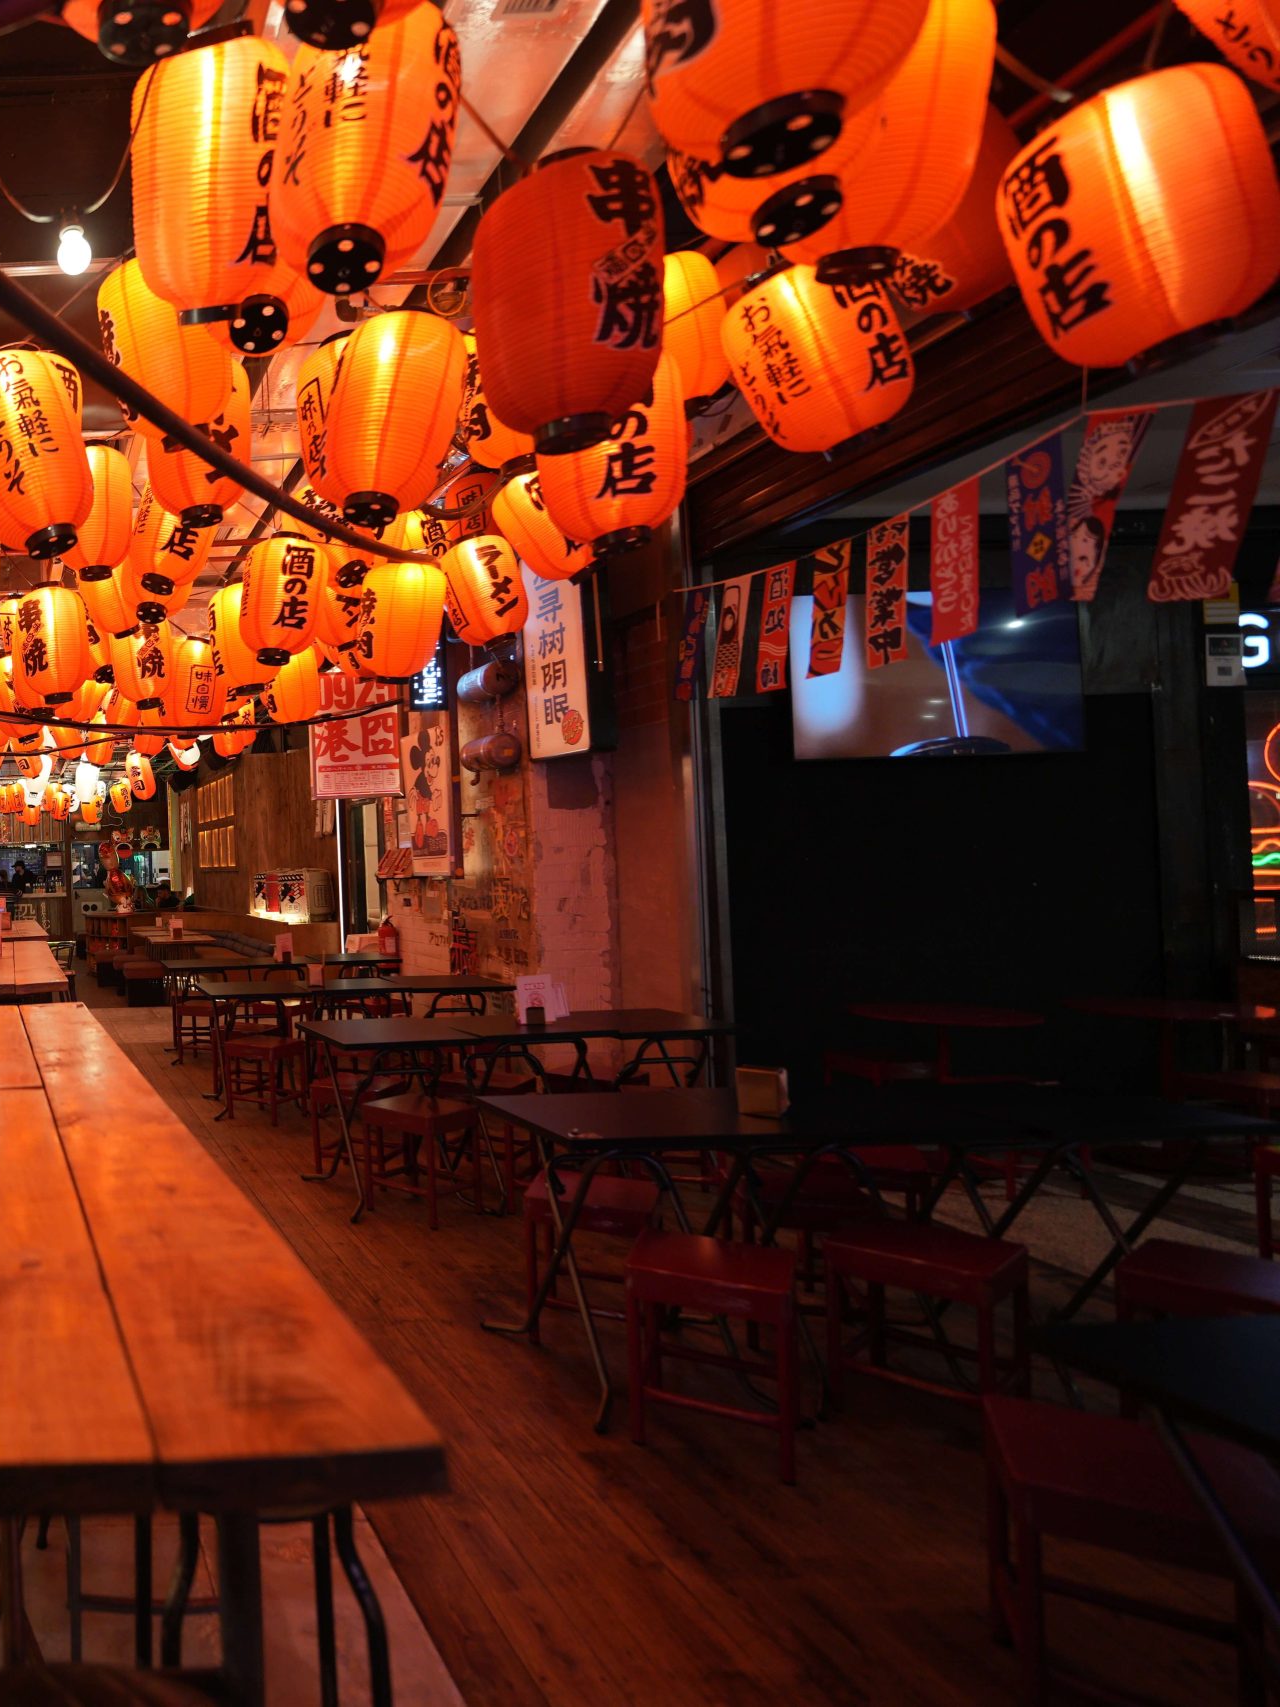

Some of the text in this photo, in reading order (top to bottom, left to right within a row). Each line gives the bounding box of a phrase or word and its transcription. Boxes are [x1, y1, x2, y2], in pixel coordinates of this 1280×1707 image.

[586, 159, 661, 349] 串焼
[160, 525, 200, 562] 店
[272, 544, 315, 630] 酒の店
[475, 544, 519, 618] ラーメン
[18, 600, 48, 677] 串焼
[191, 670, 213, 711] 味自慢
[314, 711, 399, 763] 港囧
